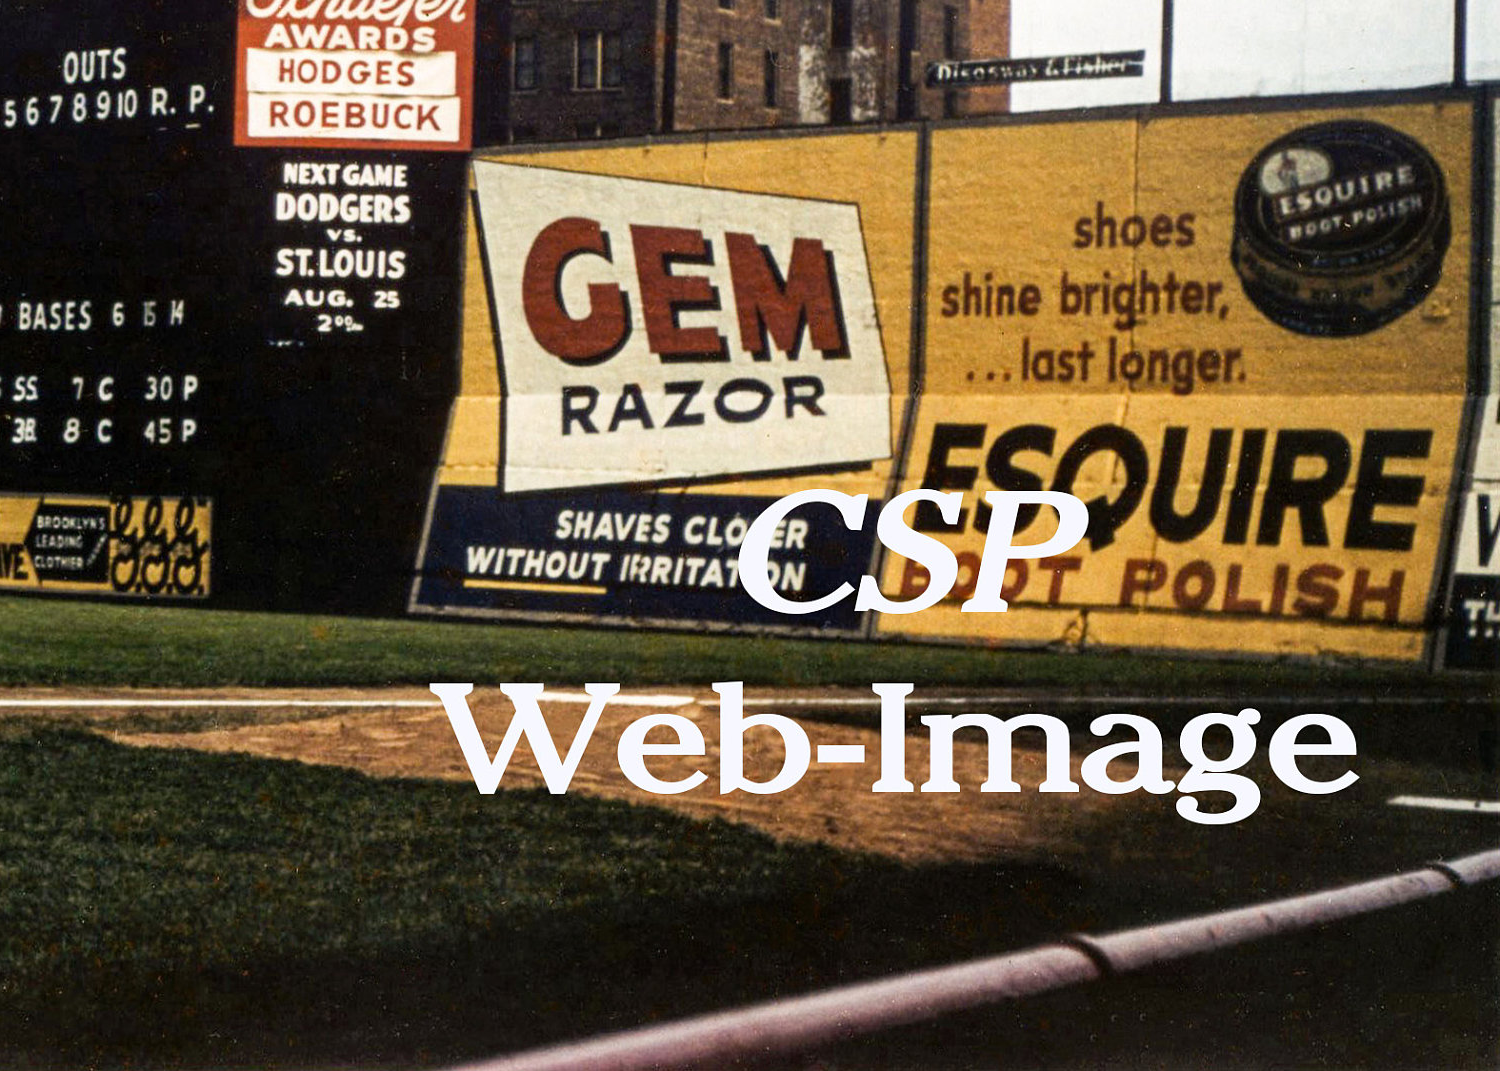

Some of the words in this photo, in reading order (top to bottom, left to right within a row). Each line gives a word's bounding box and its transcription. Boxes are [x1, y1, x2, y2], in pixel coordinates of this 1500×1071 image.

[264, 23, 437, 53] AWARDS
[63, 46, 127, 85] OUTS
[278, 57, 416, 87] HODGES
[4, 99, 17, 128] 5
[25, 96, 40, 126] 6
[49, 94, 63, 124] 7
[72, 92, 87, 123] 8
[96, 90, 111, 120] 9
[117, 88, 138, 119] 10
[150, 87, 176, 116] R.
[189, 84, 214, 113] P.
[269, 100, 441, 131] ROEBUCK
[283, 163, 342, 186] NEXT
[342, 164, 409, 188] GAME
[1279, 164, 1416, 215] ESQUIRE
[275, 191, 412, 224] DODGERS
[1073, 201, 1197, 249] shoes
[283, 288, 355, 308] AUG.
[372, 290, 401, 309] 25
[522, 216, 852, 367] GEM
[941, 272, 1042, 318] shine
[1060, 271, 1231, 327] brighter,
[18, 300, 92, 331] BASES
[112, 302, 125, 327] 6
[1108, 336, 1248, 394] longer.
[144, 375, 173, 401] 30
[183, 374, 199, 401] P
[561, 376, 827, 435] RAZOR
[143, 417, 171, 444] 45
[182, 418, 197, 442] P
[911, 422, 1434, 554] ESQUIRE
[36, 514, 107, 531] BROOKLYN'S
[555, 510, 671, 545] SHAVES
[684, 514, 809, 550] CLOER
[34, 534, 84, 549] LEADING
[33, 556, 85, 571] CLOTHIER
[467, 547, 611, 582] WITHOUT
[619, 556, 807, 592] IRRITATON
[1119, 558, 1406, 622] POLISH
